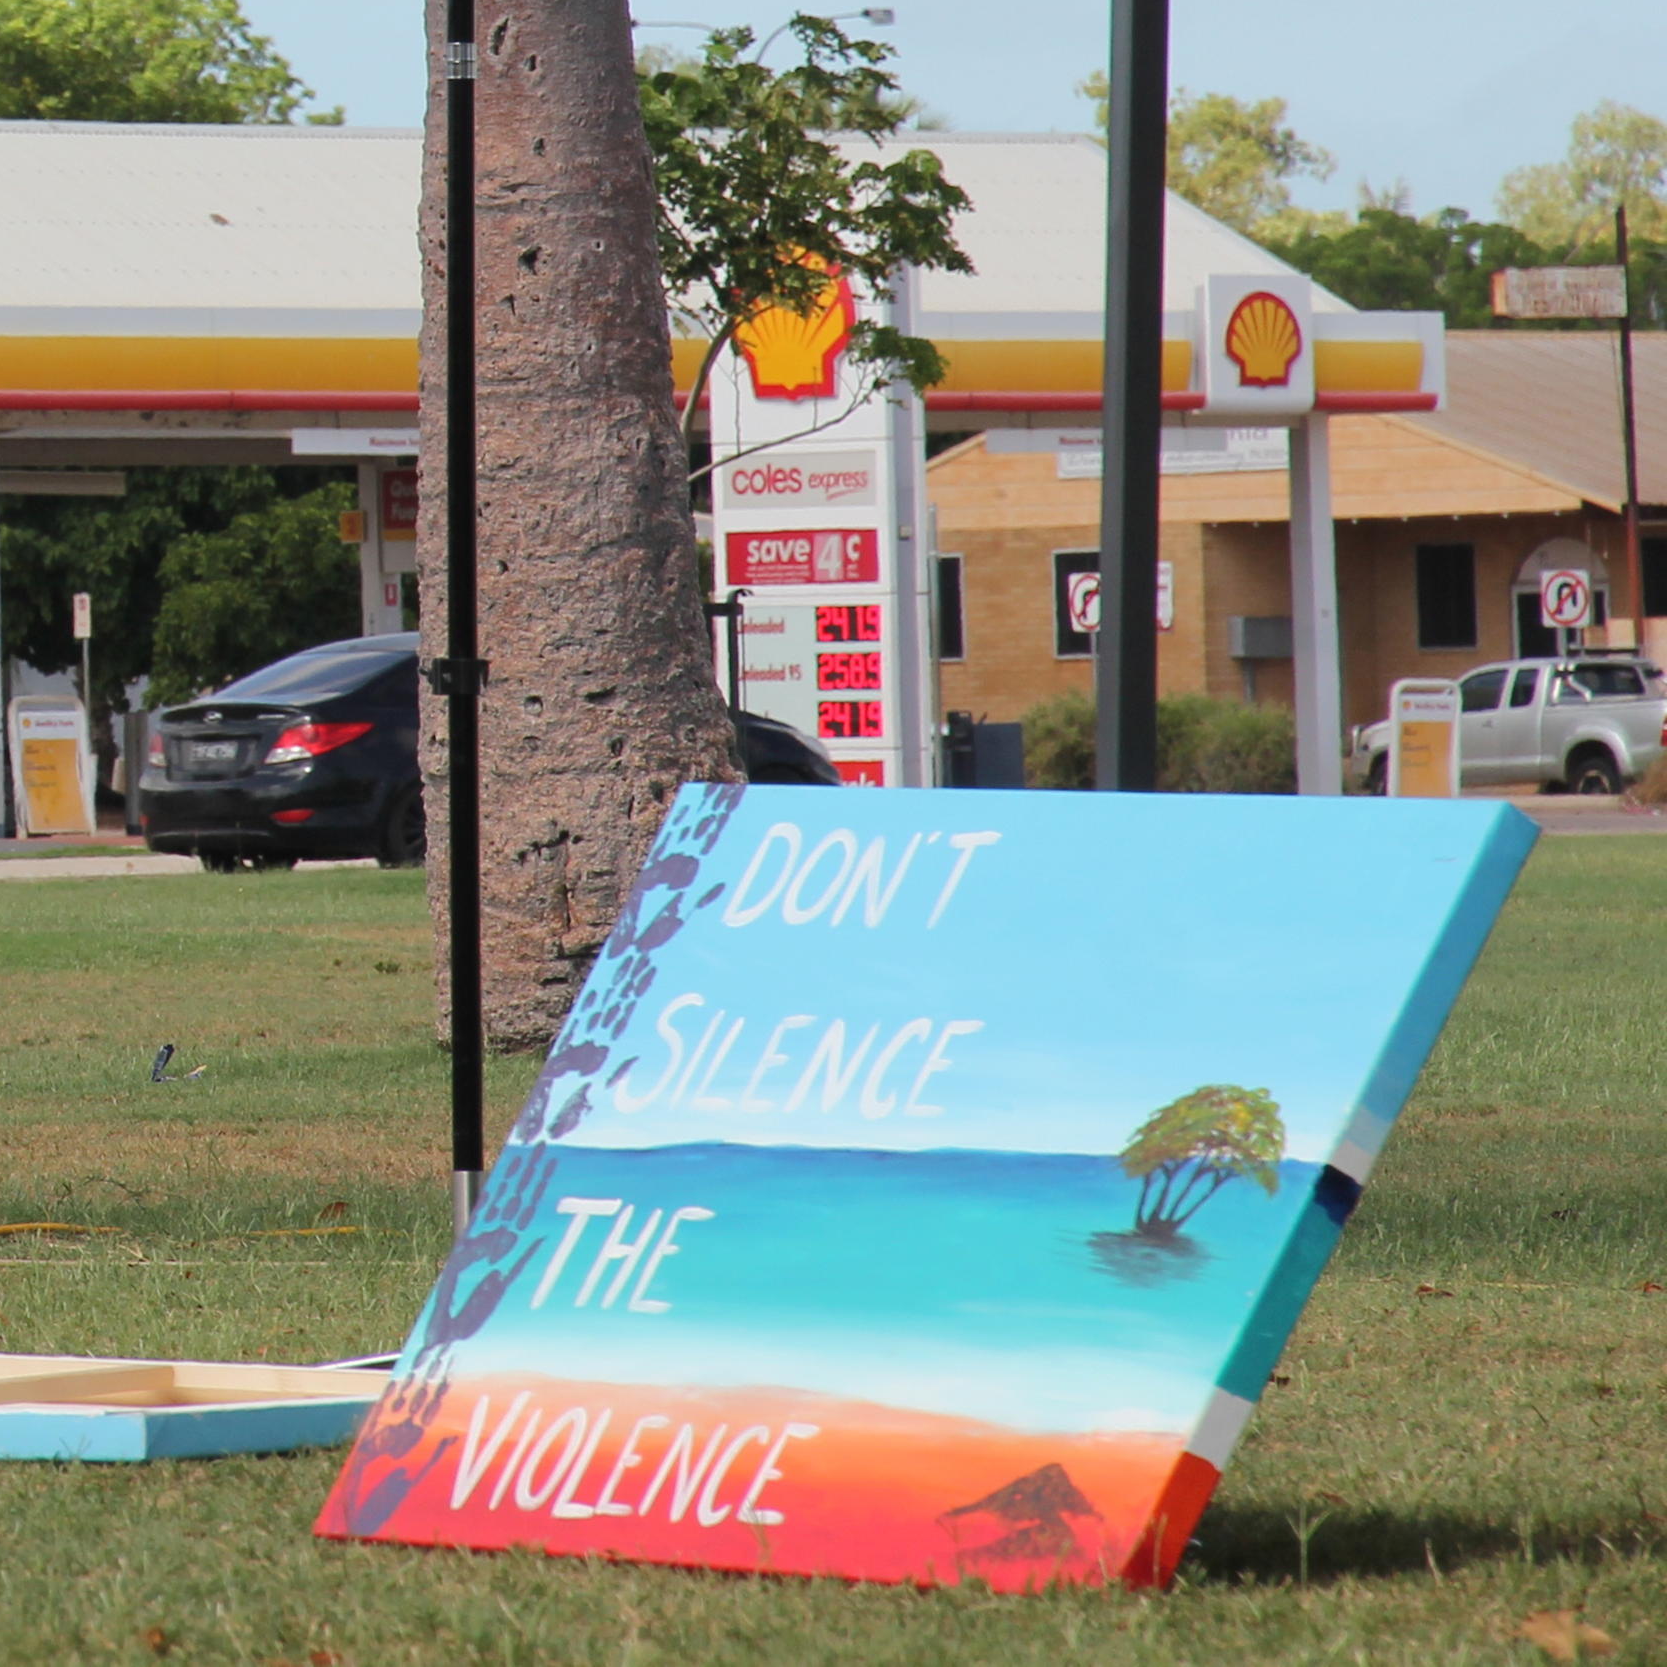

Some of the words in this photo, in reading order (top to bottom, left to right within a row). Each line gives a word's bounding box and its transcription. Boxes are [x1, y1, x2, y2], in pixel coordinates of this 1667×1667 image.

[732, 463, 802, 495] coles
[808, 470, 869, 493] express
[747, 538, 811, 564] save
[722, 822, 1004, 929] DON'T
[614, 993, 986, 1119] SILENCE
[529, 1197, 715, 1314] THE
[449, 1390, 821, 1526] VIOLENCE
